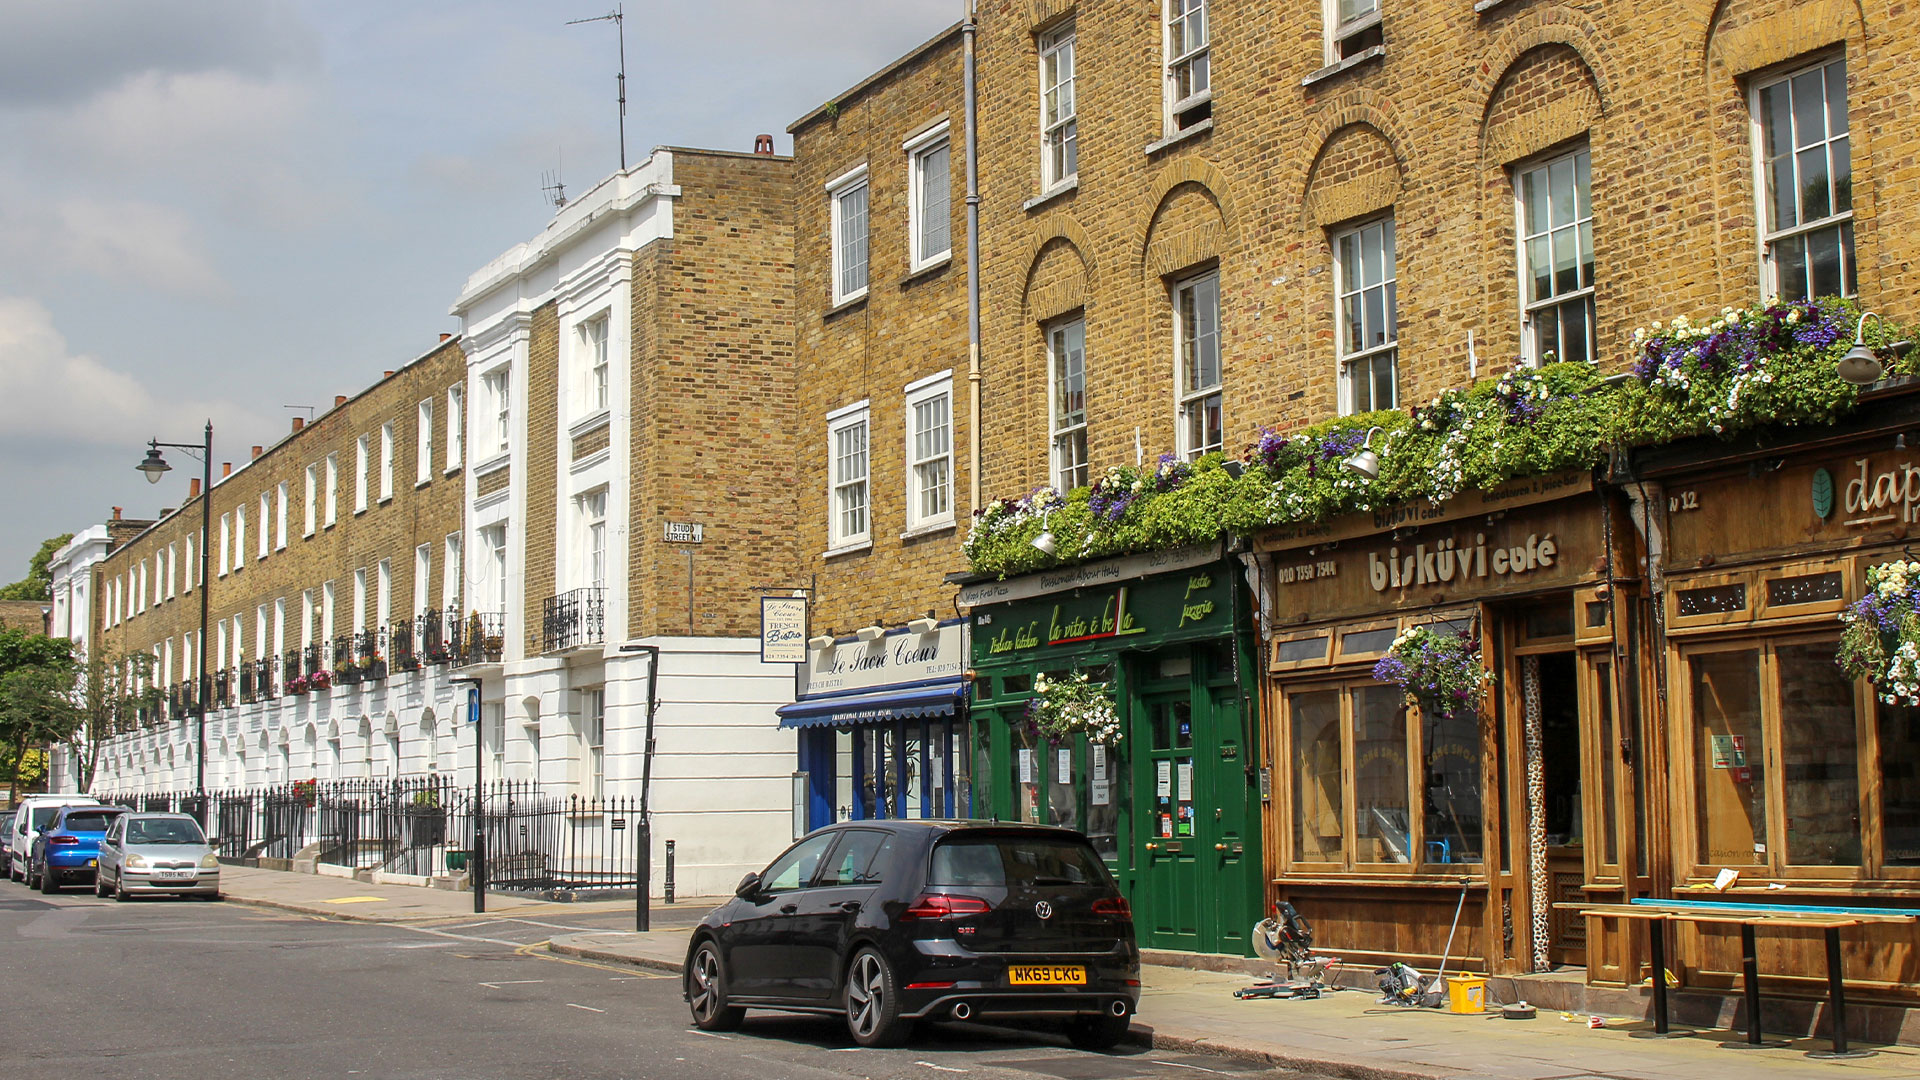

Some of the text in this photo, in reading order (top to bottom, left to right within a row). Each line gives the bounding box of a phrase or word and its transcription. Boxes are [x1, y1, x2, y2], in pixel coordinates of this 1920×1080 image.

[1681, 491, 1698, 510] 12
[672, 524, 695, 533] STUDD
[666, 533, 690, 541] STREET
[1369, 533, 1557, 592] bisküvi café
[1076, 567, 1099, 583] About
[1101, 564, 1120, 578] Italy
[993, 586, 1009, 596] Pizza
[768, 622, 799, 630] FRENCH
[1064, 615, 1088, 638] vita
[766, 629, 802, 643] Bistro
[828, 648, 846, 676] Le
[850, 645, 889, 673] Sacré
[894, 638, 940, 666] Coeur
[1015, 967, 1080, 981] MK69 CKG
